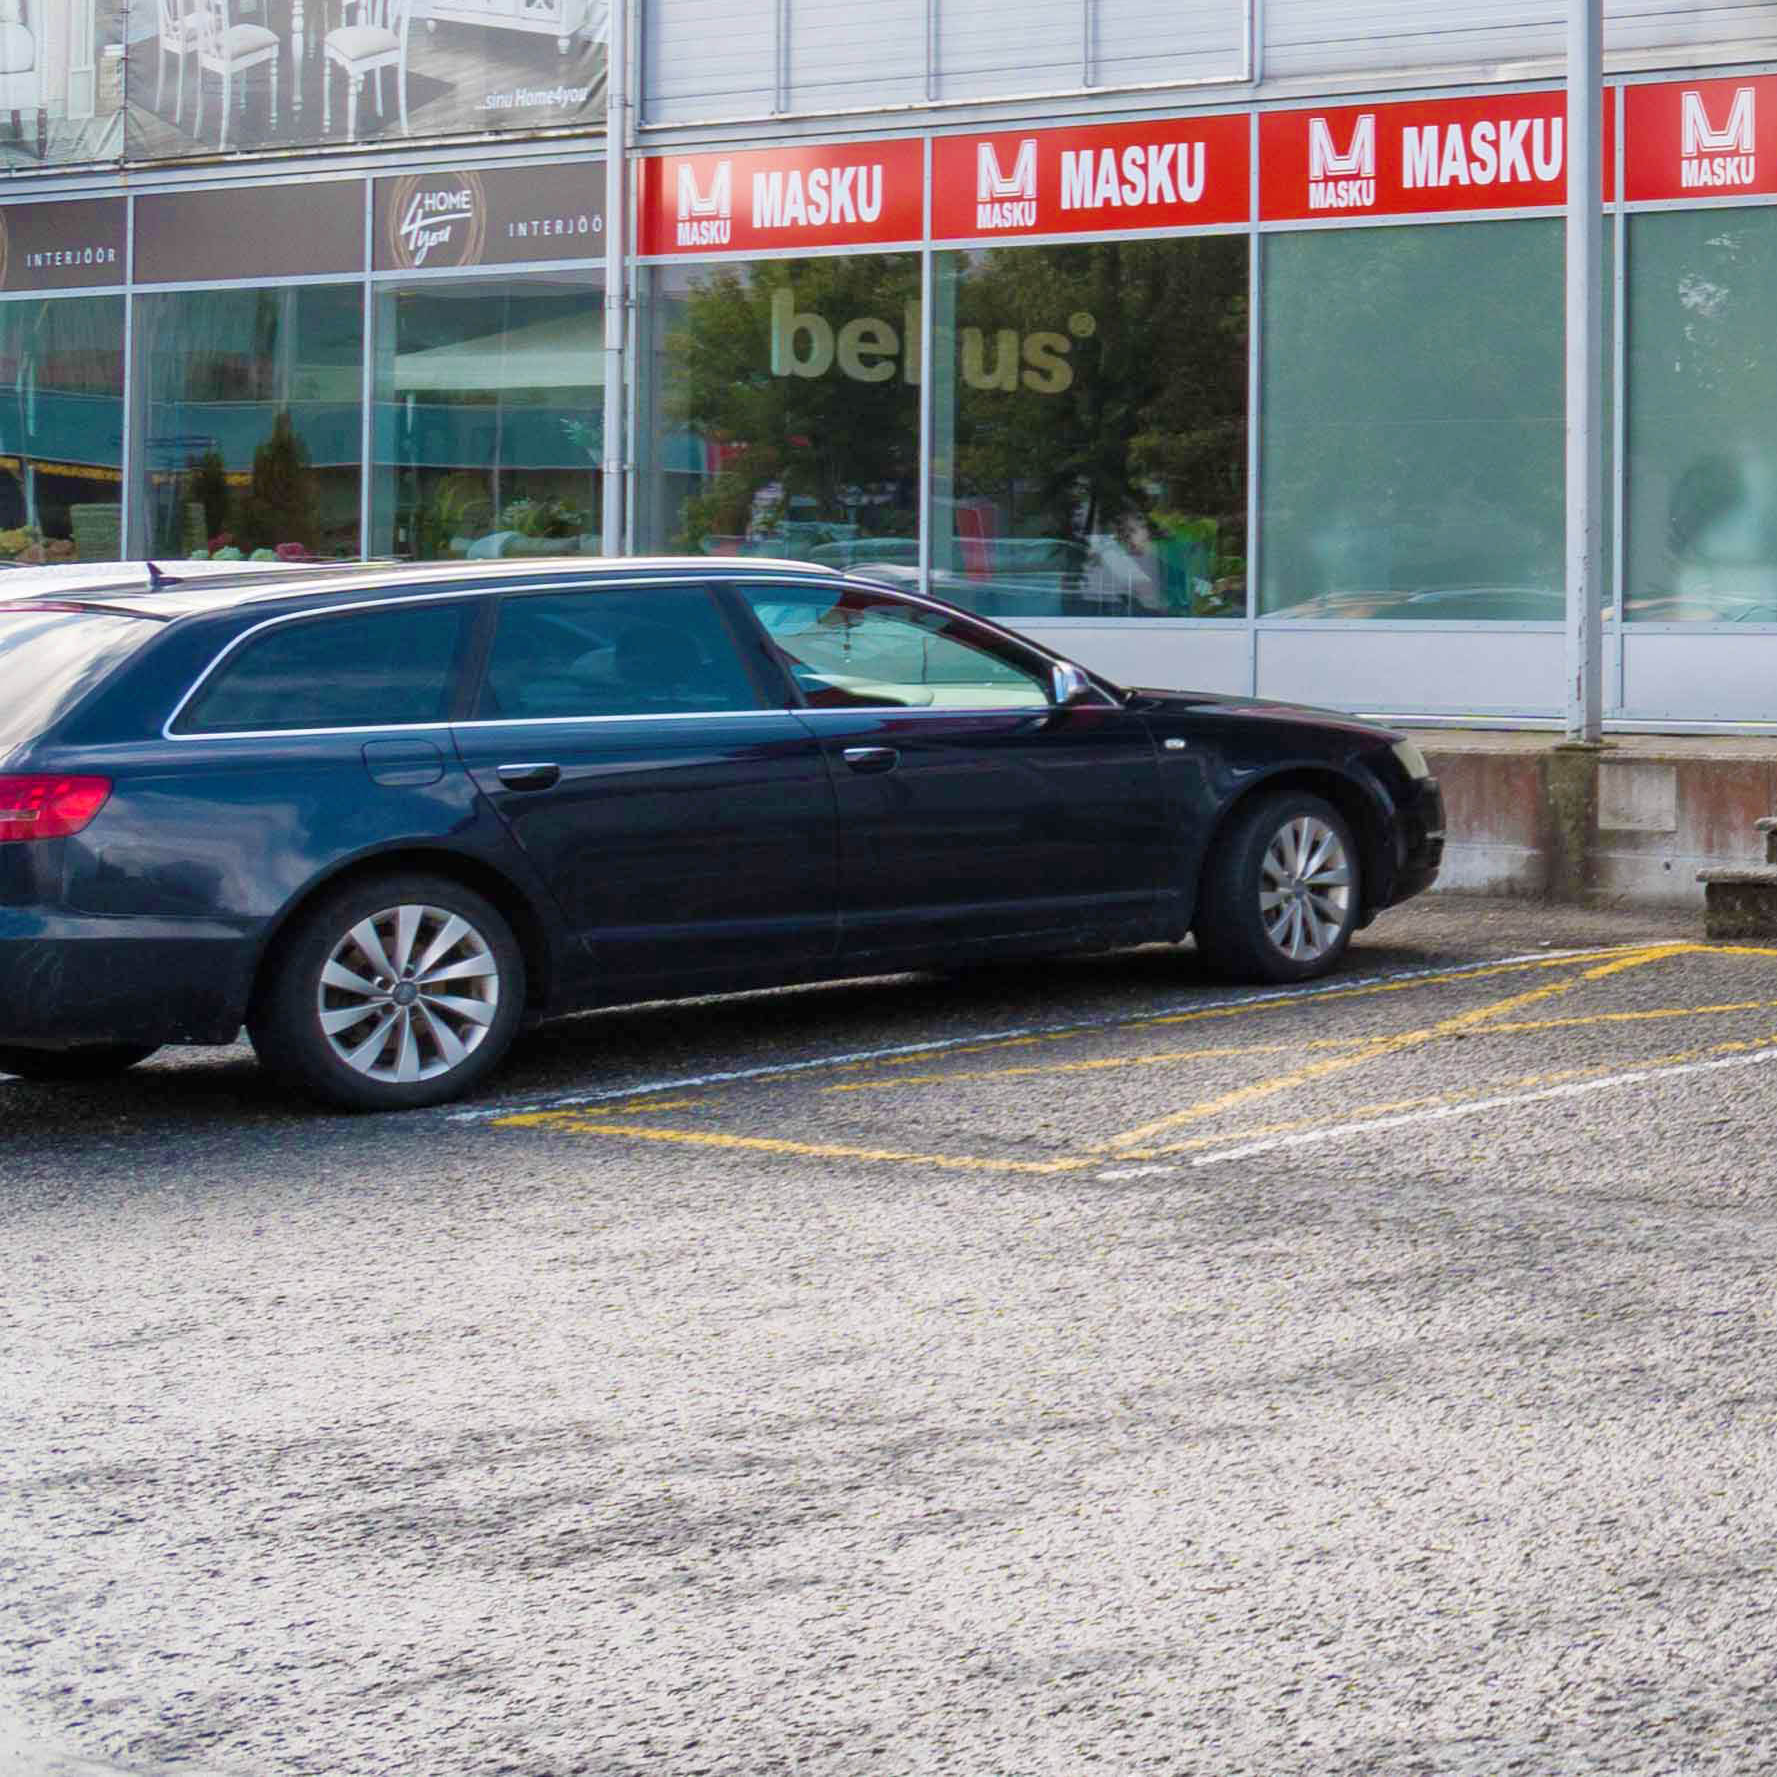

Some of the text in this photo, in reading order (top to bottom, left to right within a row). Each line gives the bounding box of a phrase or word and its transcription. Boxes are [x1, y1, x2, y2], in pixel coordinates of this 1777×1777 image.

[513, 85, 591, 110] Home4you
[1402, 116, 1563, 189] MASKU
[1060, 141, 1206, 211] MASKU
[1681, 156, 1756, 188] MASKU
[423, 189, 472, 212] HOME
[752, 165, 883, 228] MASKU
[1308, 179, 1376, 210] MASKU
[508, 215, 603, 238] INTERJÖÖ
[976, 200, 1037, 230] MASKU
[677, 219, 731, 247] MASKU
[771, 288, 1074, 395] belus
